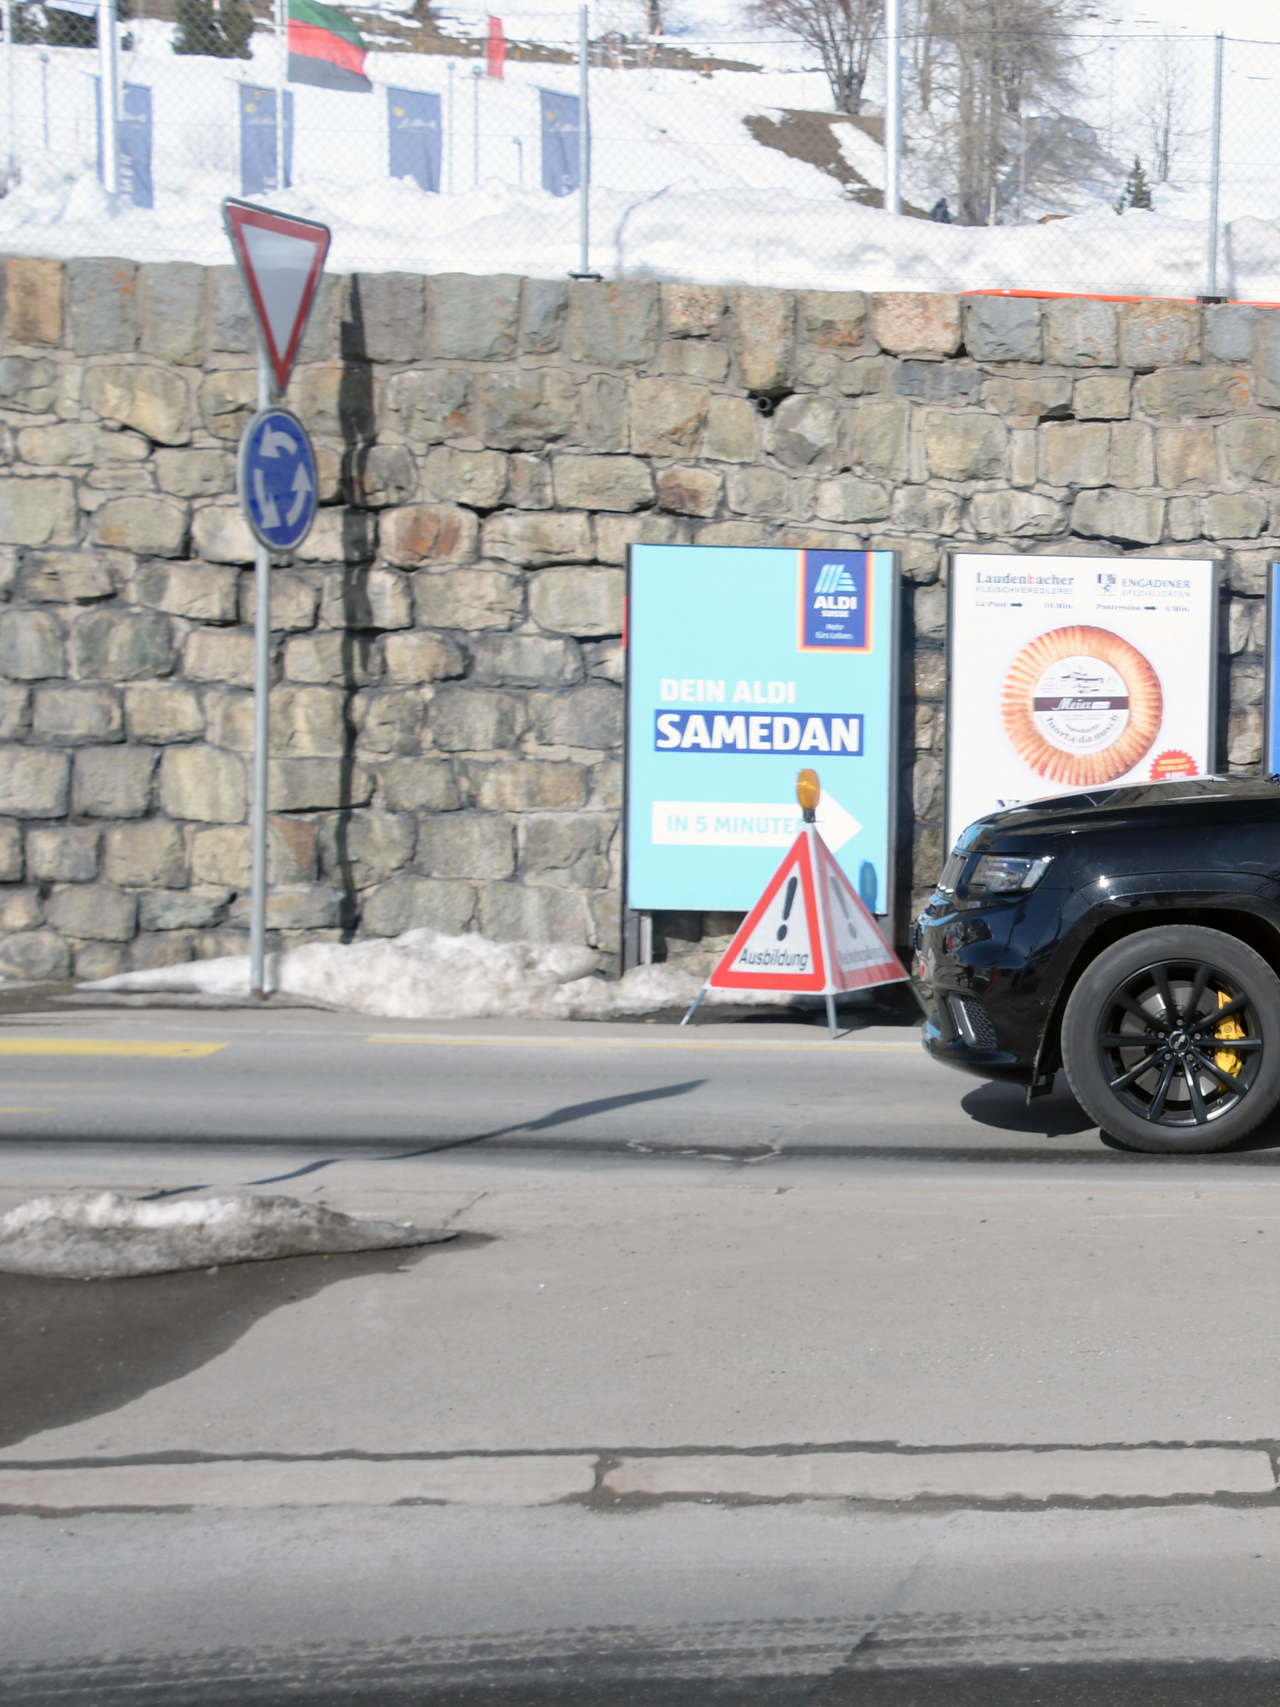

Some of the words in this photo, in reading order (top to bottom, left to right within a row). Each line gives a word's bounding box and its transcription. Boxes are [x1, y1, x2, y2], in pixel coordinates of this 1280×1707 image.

[976, 572, 1075, 585] Laudenbacher
[1122, 579, 1191, 588] ENGADINER
[813, 595, 858, 609] ALDI
[660, 678, 726, 702] DEIN
[732, 680, 796, 704] ALDI
[656, 713, 860, 752] SAMEDAN
[667, 815, 688, 832] IN
[695, 815, 707, 832] 5
[738, 948, 808, 972] Ausbildung
